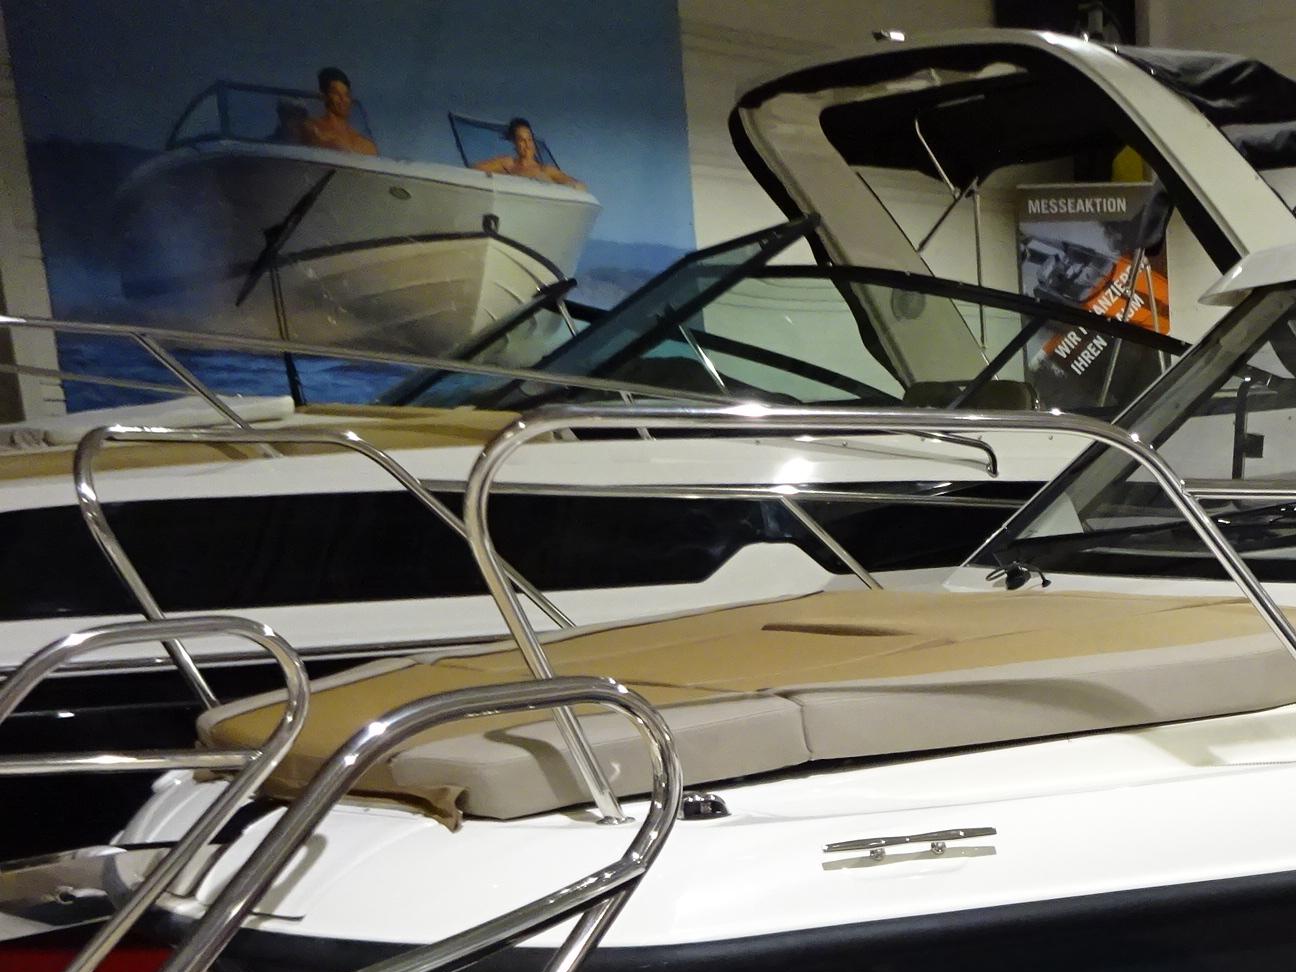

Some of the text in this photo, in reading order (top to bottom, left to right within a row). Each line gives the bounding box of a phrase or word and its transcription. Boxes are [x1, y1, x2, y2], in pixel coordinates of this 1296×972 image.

[1027, 198, 1127, 215] MESSEAKTION
[1054, 330, 1082, 359] WIR
[1070, 334, 1108, 376] IHREN
